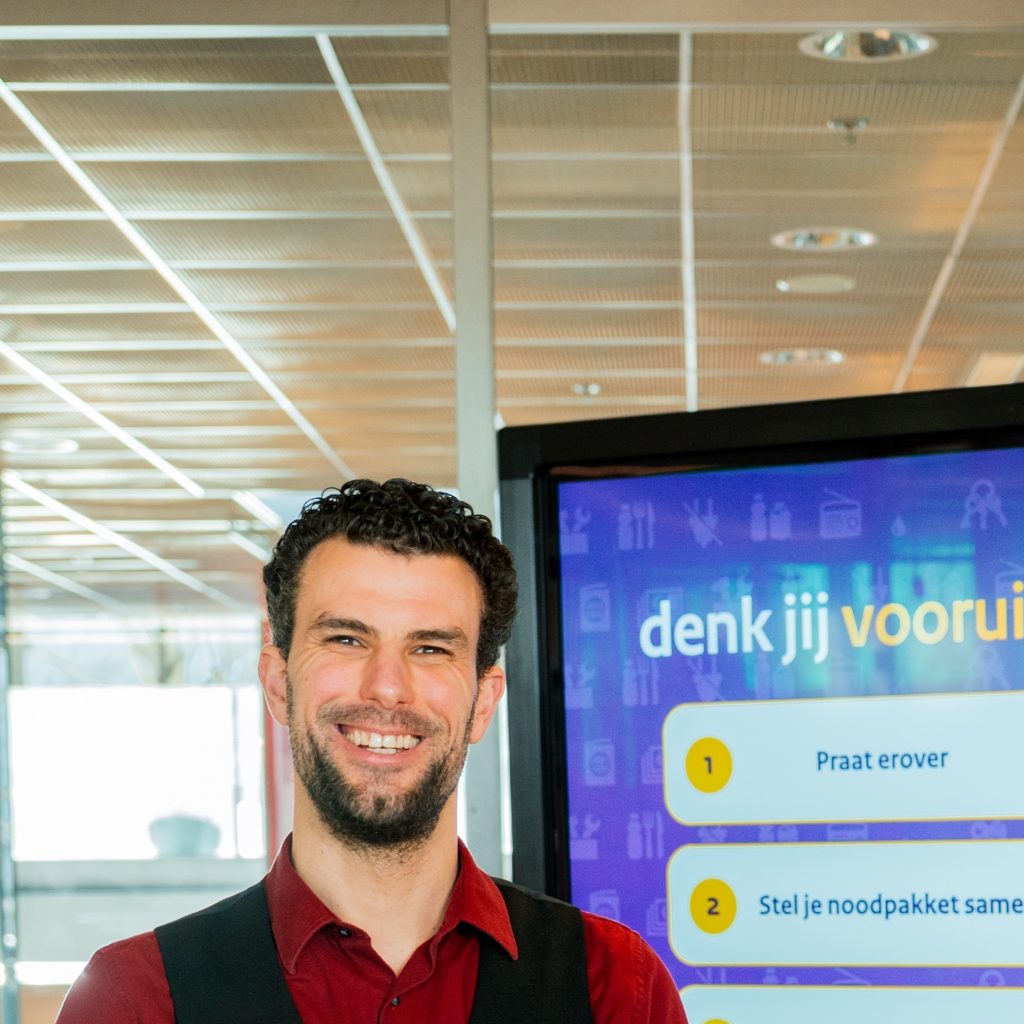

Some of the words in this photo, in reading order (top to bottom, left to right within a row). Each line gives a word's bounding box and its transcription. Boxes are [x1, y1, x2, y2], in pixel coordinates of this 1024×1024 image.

[639, 595, 774, 658] denk
[781, 591, 829, 665] jij
[704, 755, 713, 775] 1
[816, 750, 872, 772] Praat
[878, 750, 949, 769] erover
[706, 897, 720, 916] 2
[759, 894, 799, 916] Stel
[803, 895, 822, 920] je
[827, 893, 959, 920] noodpakket
